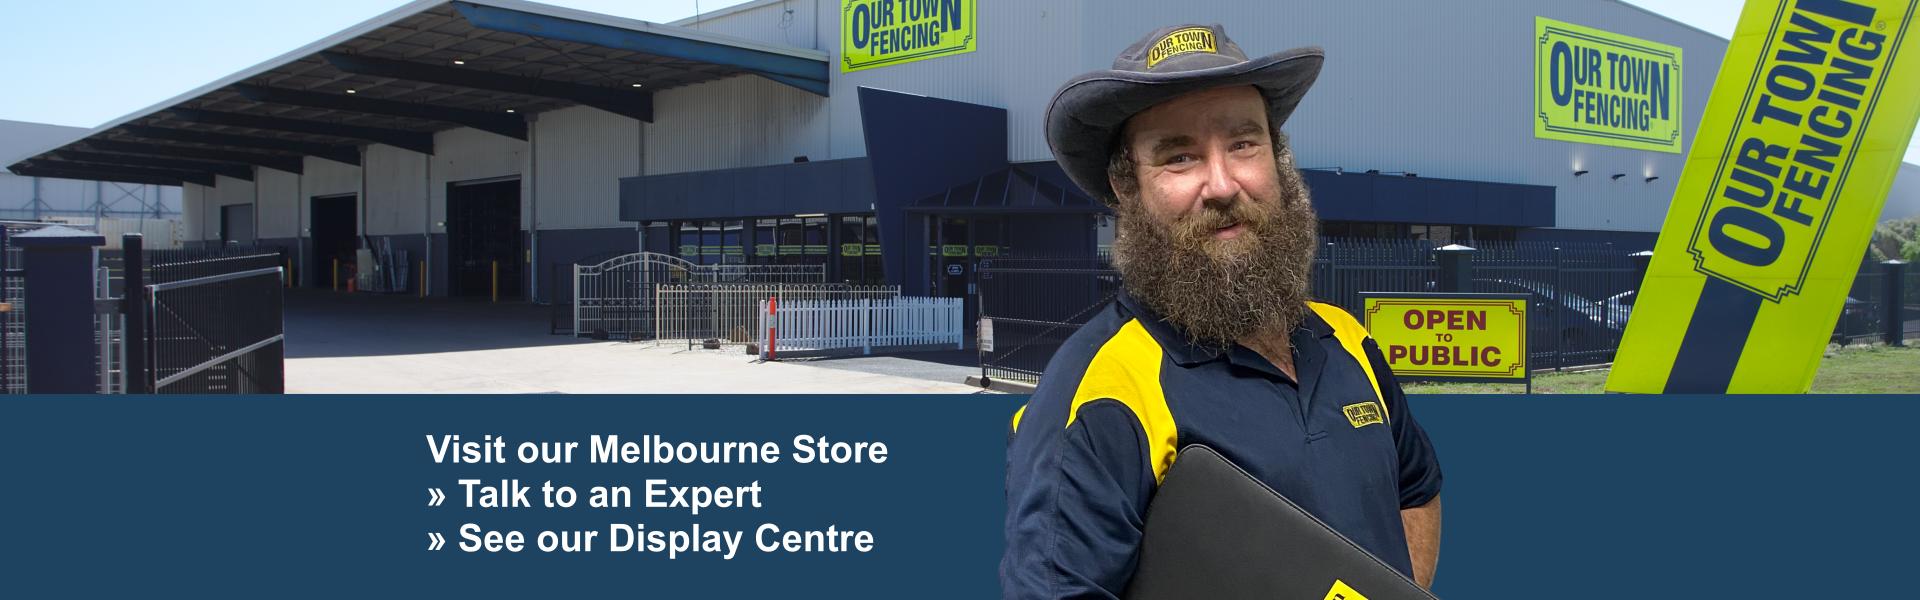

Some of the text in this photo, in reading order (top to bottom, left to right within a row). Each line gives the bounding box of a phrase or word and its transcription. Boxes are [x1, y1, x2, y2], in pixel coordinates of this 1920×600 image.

[852, 0, 961, 49] OUR TOWN
[871, 20, 940, 56] FENCING
[1152, 31, 1213, 61] OUR TOWN
[1162, 42, 1203, 58] FENCING
[1550, 41, 1669, 120] OUR TOWN
[1574, 89, 1649, 131] FENCING
[1773, 28, 1887, 227] FENCING
[1708, 137, 1790, 267] OUR
[1403, 309, 1486, 331] OPEN
[1436, 333, 1453, 342] TO
[1389, 345, 1501, 367] PUBLIC
